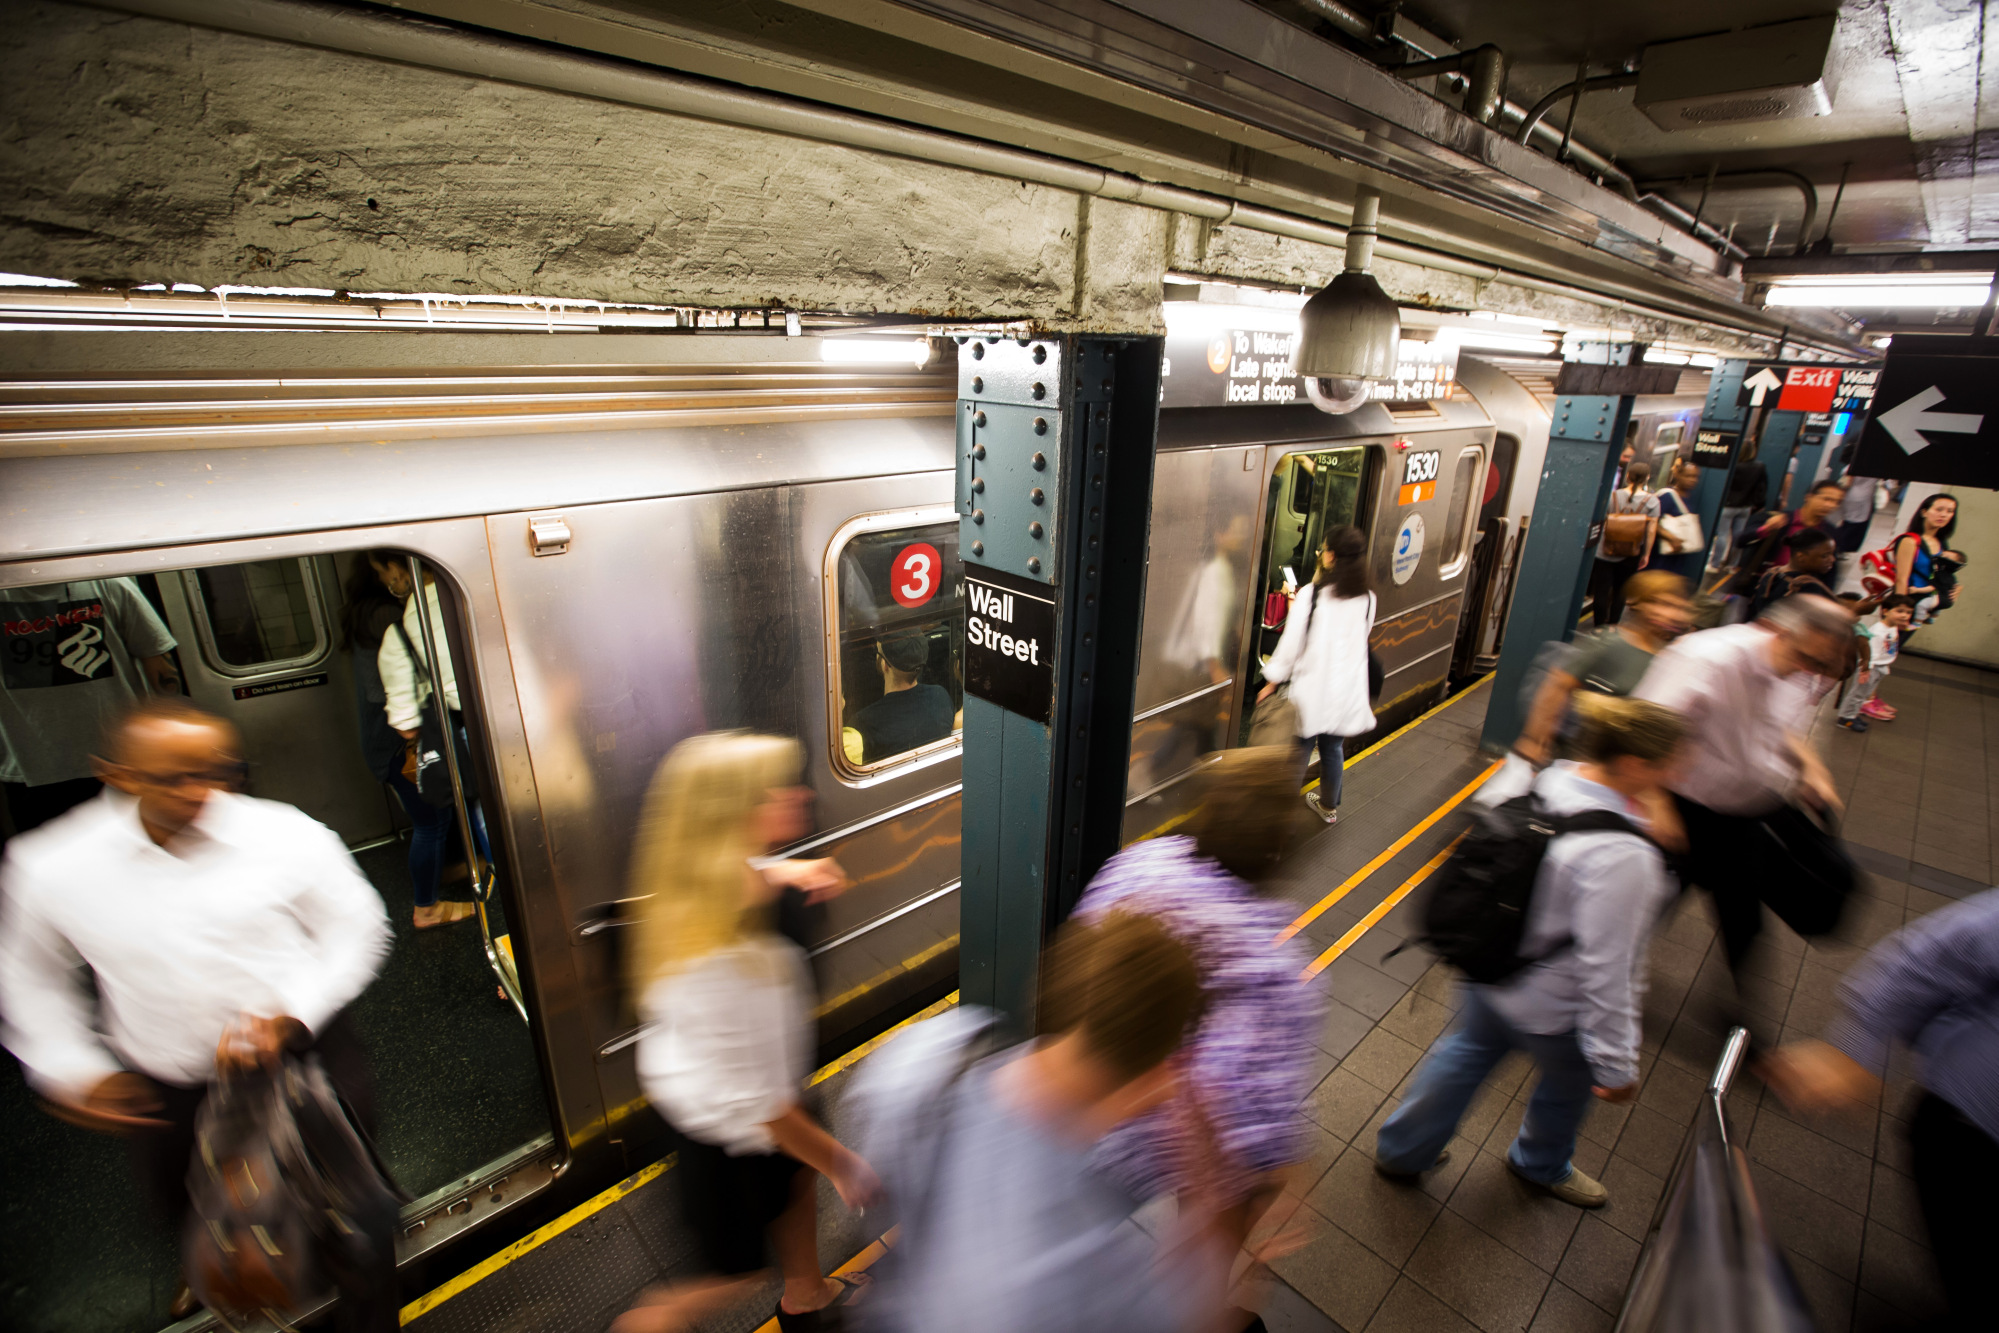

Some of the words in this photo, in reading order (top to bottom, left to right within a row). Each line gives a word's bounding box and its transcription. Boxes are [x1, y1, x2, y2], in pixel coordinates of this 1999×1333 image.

[1212, 339, 1226, 365] 2
[1233, 330, 1250, 354] To
[1253, 332, 1293, 355] Wakef
[1229, 355, 1260, 378] Late
[1784, 367, 1835, 388] Exit
[1842, 370, 1879, 385] Wall
[1228, 380, 1260, 402] local
[1263, 382, 1296, 404] stops
[1695, 441, 1729, 454] Street
[1698, 433, 1721, 444] Wall
[1317, 455, 1338, 466] 1530
[1406, 451, 1440, 484] 1530
[901, 553, 931, 599] 3
[968, 583, 1014, 623] Wall
[967, 616, 1039, 666] Street
[251, 687, 263, 695] Do
[276, 682, 292, 690] lean
[292, 680, 303, 688] on
[303, 678, 320, 686] door
